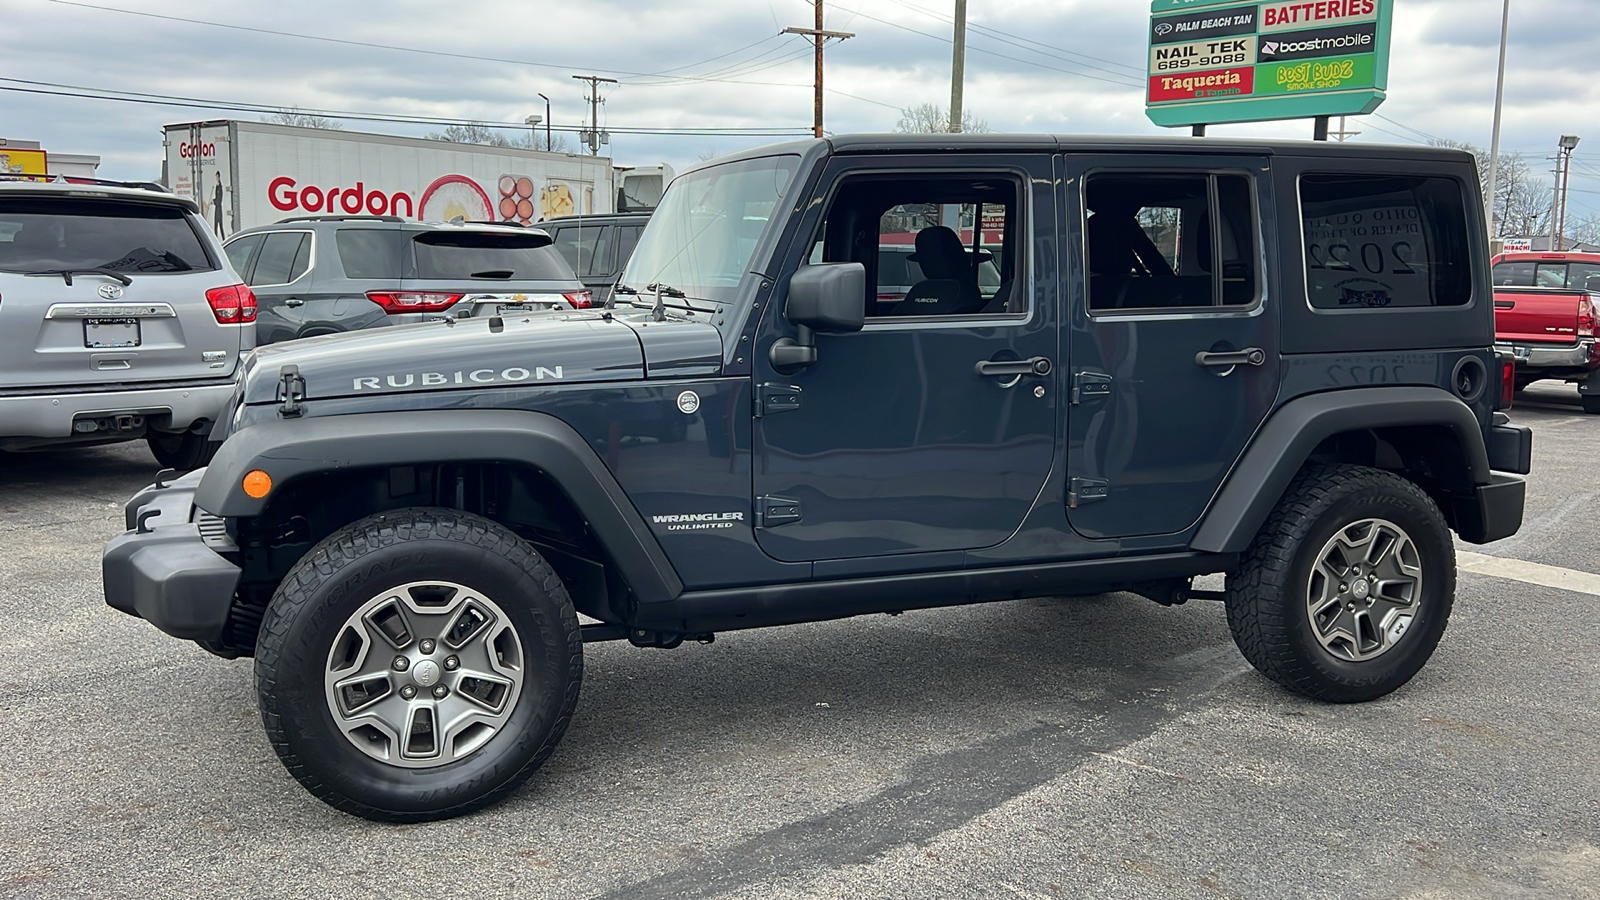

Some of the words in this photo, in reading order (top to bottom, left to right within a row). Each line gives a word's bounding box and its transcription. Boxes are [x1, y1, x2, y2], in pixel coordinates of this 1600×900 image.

[1264, 0, 1374, 26] BATTERIES
[1175, 21, 1200, 32] PALM
[1201, 17, 1231, 29] BEACH
[1233, 14, 1252, 25] TAN
[1157, 46, 1198, 60] NAIL
[1207, 39, 1247, 54] TEK
[1158, 53, 1245, 70] 689-9088
[1313, 59, 1354, 81] BUDZ
[1286, 81, 1315, 91] SMOKE
[1316, 79, 1341, 89] SHOP
[268, 176, 413, 216] Gordon
[75, 307, 151, 316] SEQUOIA
[353, 365, 564, 390] RUBICON
[652, 511, 744, 524] WRANGLER
[667, 522, 734, 531] UNLIMITED
